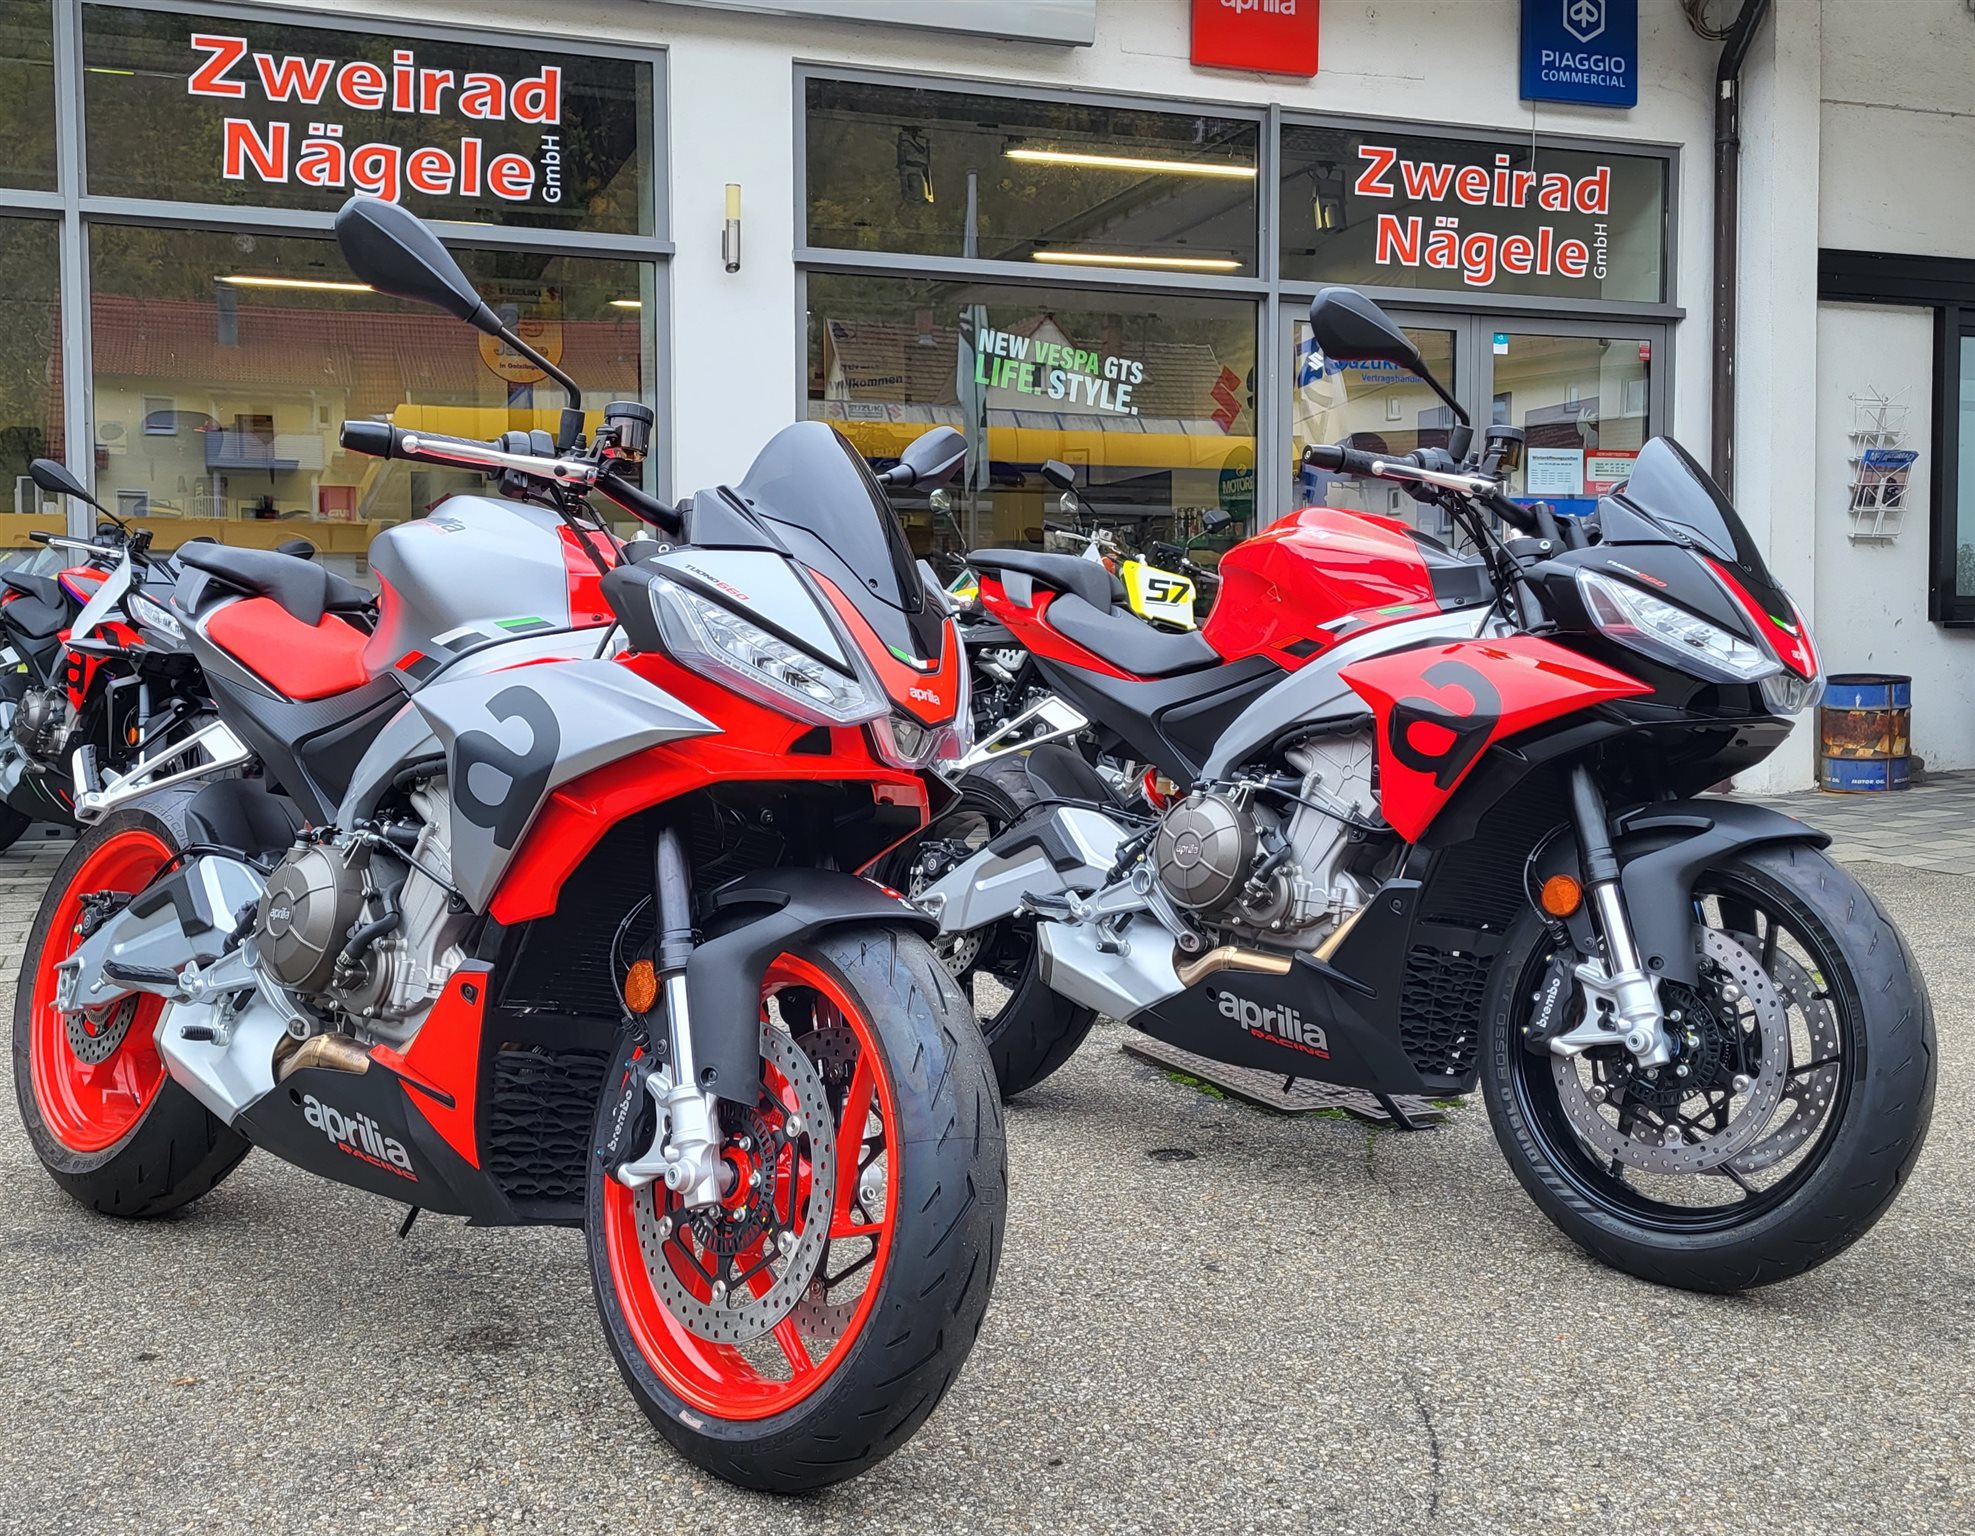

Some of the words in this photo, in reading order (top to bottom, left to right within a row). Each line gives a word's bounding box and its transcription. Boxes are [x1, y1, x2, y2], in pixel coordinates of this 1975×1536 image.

[188, 32, 562, 125] Zweirad
[1541, 49, 1626, 73] PIAGGIO
[1541, 69, 1626, 88] COMMERCIAL
[223, 117, 535, 203] Nägele
[542, 135, 562, 203] GmbH
[1354, 145, 1611, 215] Zweirad
[1375, 213, 1589, 286] Nägele
[1593, 223, 1608, 279] GmbH
[975, 353, 1041, 396] LIFE.
[1047, 369, 1139, 415] STYLE.
[978, 328, 1030, 360] NEW
[1035, 340, 1099, 375] VESPA
[1104, 356, 1144, 384] GTS
[1145, 578, 1191, 605] 57
[909, 687, 941, 706] aprilia
[1219, 991, 1329, 1051] aprilia
[1536, 977, 1561, 1029] brembo
[1249, 1028, 1331, 1060] RACING
[1496, 1012, 1508, 1081] ROSSO
[303, 1094, 415, 1172] aprilia
[607, 1089, 633, 1152] brembo
[1500, 1086, 1540, 1164] DIABLO
[338, 1141, 419, 1183] RACING
